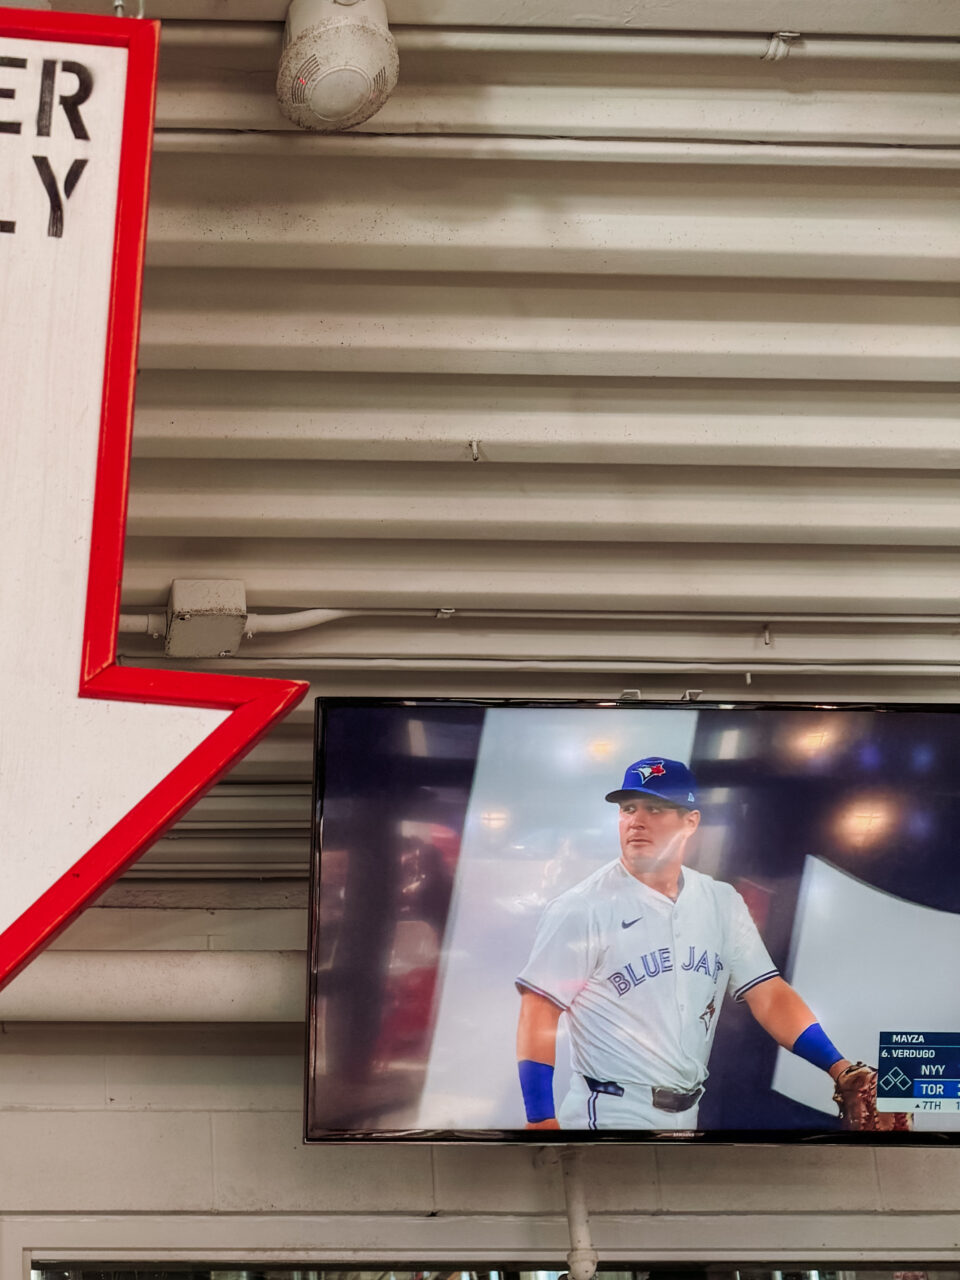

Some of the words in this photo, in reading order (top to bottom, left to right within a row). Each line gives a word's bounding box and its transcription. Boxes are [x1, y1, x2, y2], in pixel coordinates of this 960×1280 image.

[607, 947, 673, 997] BLUE
[892, 1034, 925, 1043] MAYZA
[892, 1049, 935, 1058] VERDUGO
[921, 1065, 945, 1075] NYY
[920, 1084, 944, 1095] TOR
[922, 1101, 941, 1110] 7TH
